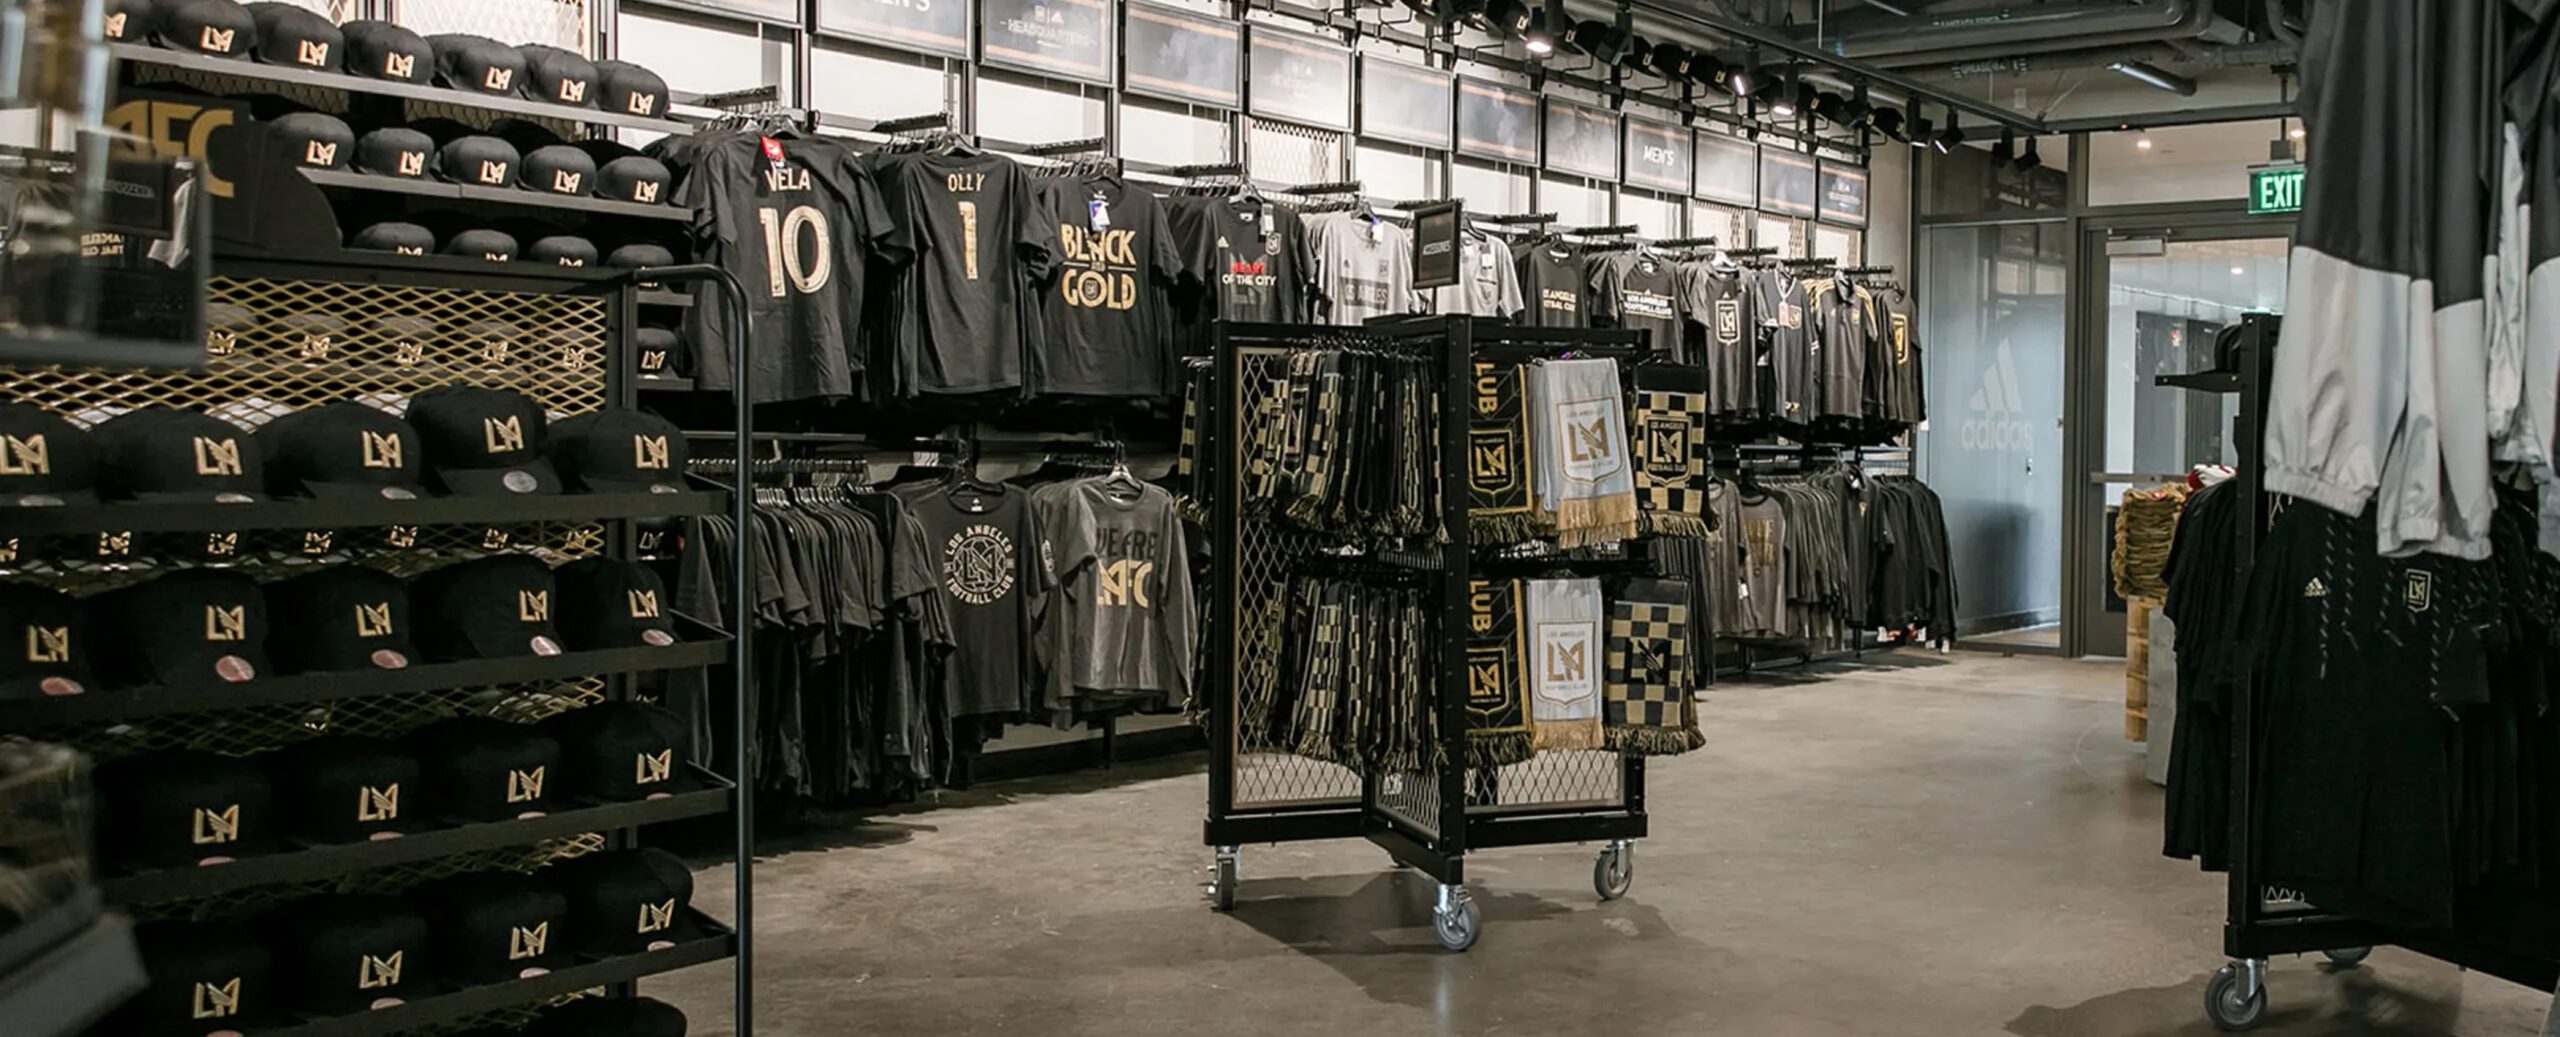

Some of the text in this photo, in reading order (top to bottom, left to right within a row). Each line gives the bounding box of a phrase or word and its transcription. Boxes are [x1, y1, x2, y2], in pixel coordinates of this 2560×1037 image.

[1007, 19, 1089, 46] HEADQUARTERS
[1643, 145, 1675, 167] MEN'S
[764, 167, 812, 192] VELA
[948, 173, 985, 192] OLLY
[2260, 174, 2304, 209] EXIT
[759, 204, 831, 297] 10
[958, 200, 978, 280] 1
[1061, 268, 1137, 311] GOLD
[1222, 273, 1277, 287] OF THE CITY
[1961, 412, 2034, 451] adidas
